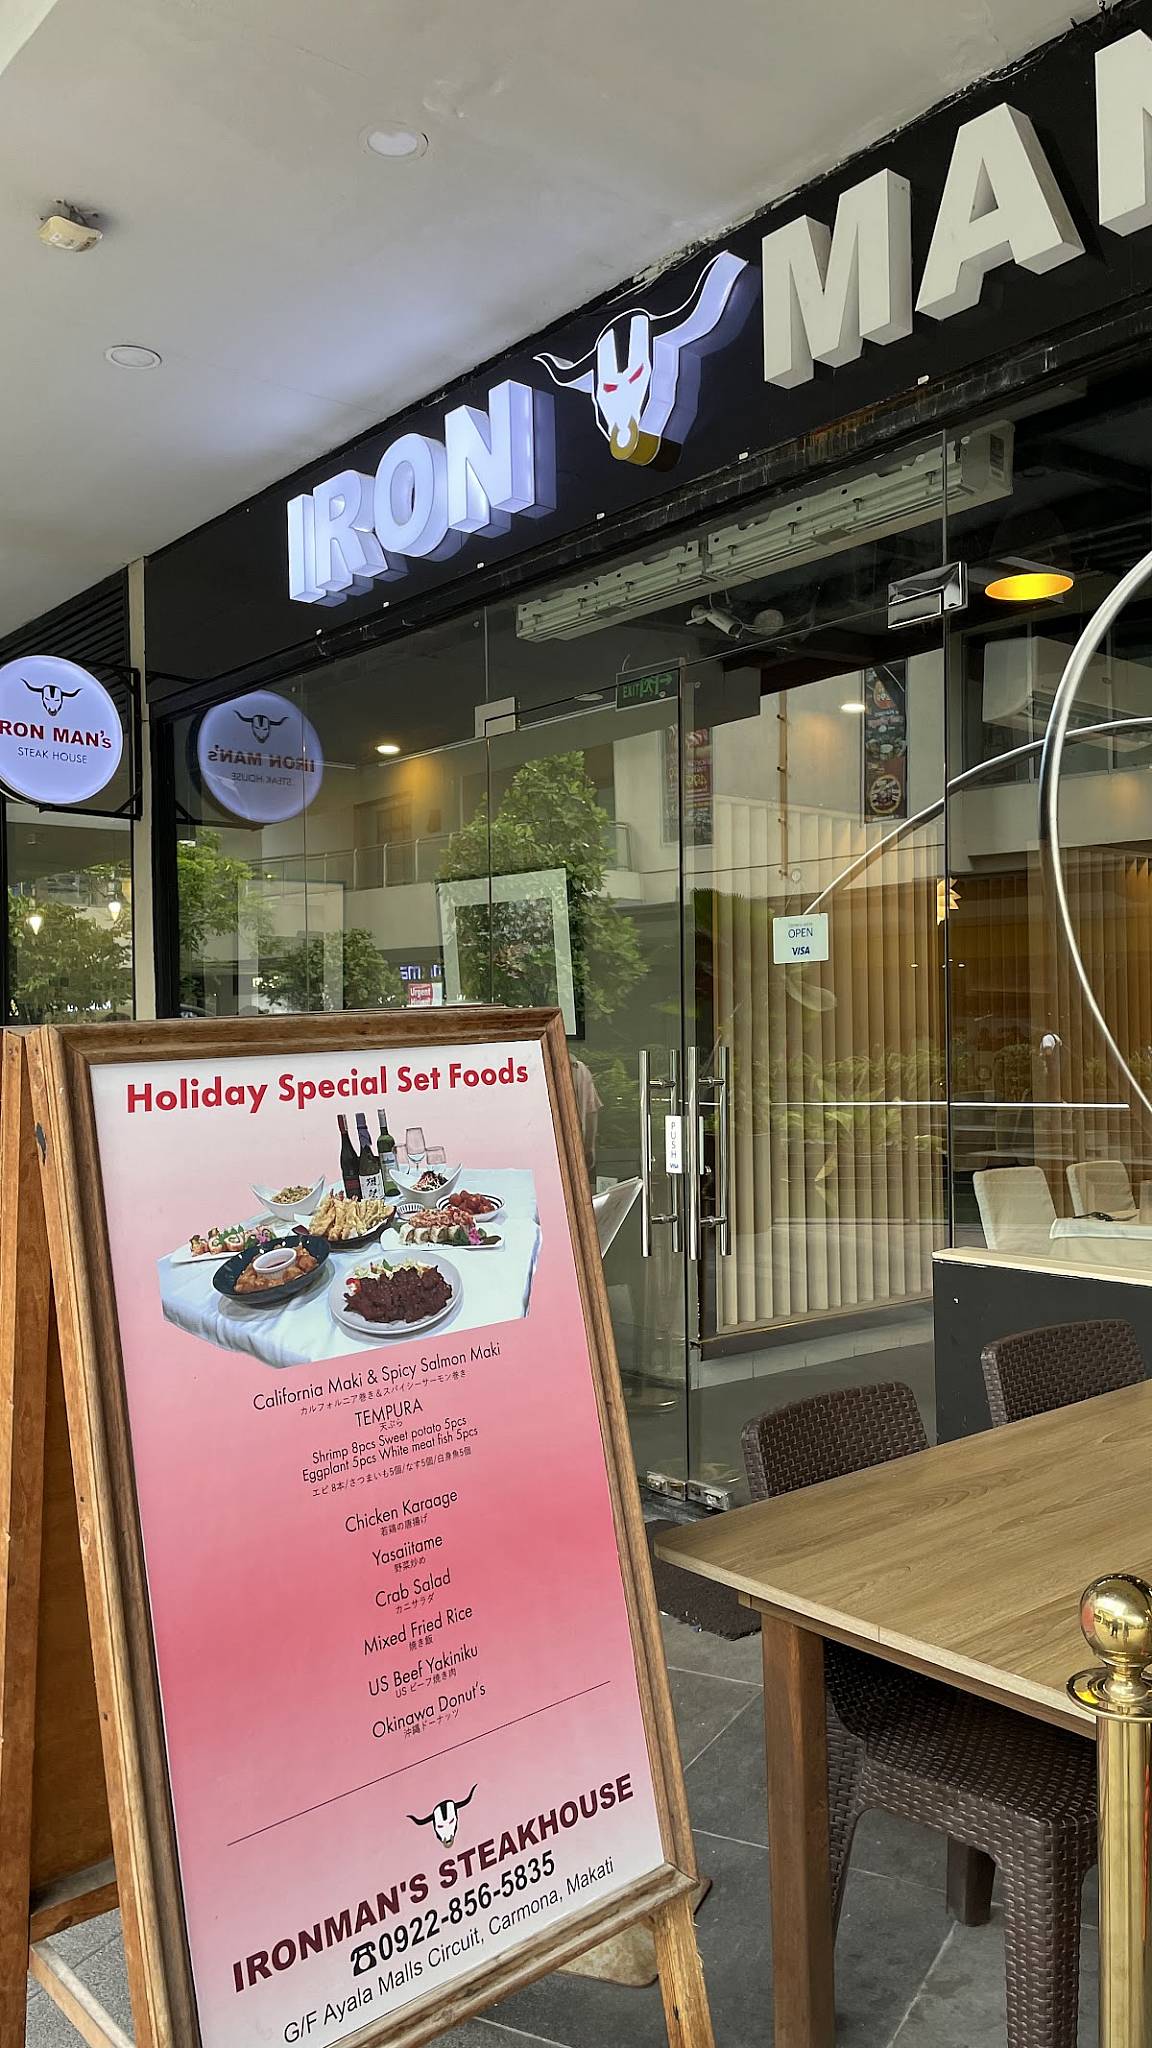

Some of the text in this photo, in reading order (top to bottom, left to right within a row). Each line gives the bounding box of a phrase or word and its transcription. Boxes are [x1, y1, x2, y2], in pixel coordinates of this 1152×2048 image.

[288, 380, 534, 603] IRON
[624, 683, 641, 698] EXIT
[0, 720, 44, 740] RON
[18, 746, 88, 764] STEAK HOUSE
[788, 927, 814, 939] OPEN
[792, 946, 811, 956] VISA
[127, 1058, 529, 1114] Holiday Special Set Foods
[253, 1342, 501, 1411] California Maki & Spicy Salmon Maki
[354, 1398, 423, 1428] TEMPURA
[379, 1418, 403, 1433] 天ぷら
[302, 1426, 478, 1483] Eggplant 5pcs White meat fish 5pcs
[312, 1417, 467, 1464] Shrimp 8pcs Sweet potato 5pcs
[345, 1491, 458, 1533] Chicken Karaage
[372, 1536, 443, 1567] Yasaiitame
[394, 1556, 426, 1573] 野菜炒め
[375, 1567, 451, 1607] Crab Salad
[395, 1592, 435, 1614] カニサラダ
[364, 1607, 473, 1655] Mixed Fried Rice
[409, 1634, 434, 1651] 焼き飯
[368, 1643, 478, 1696] US Beef Yakiniku
[372, 1681, 486, 1738] Okinawa Donut's
[232, 1773, 634, 1993] IRONMAN'S STEAKHOUSE
[378, 1850, 555, 1961] 0922-856-5835
[284, 1856, 615, 2043] G/F Ayala Malls Circuit, Carmona, Makati
